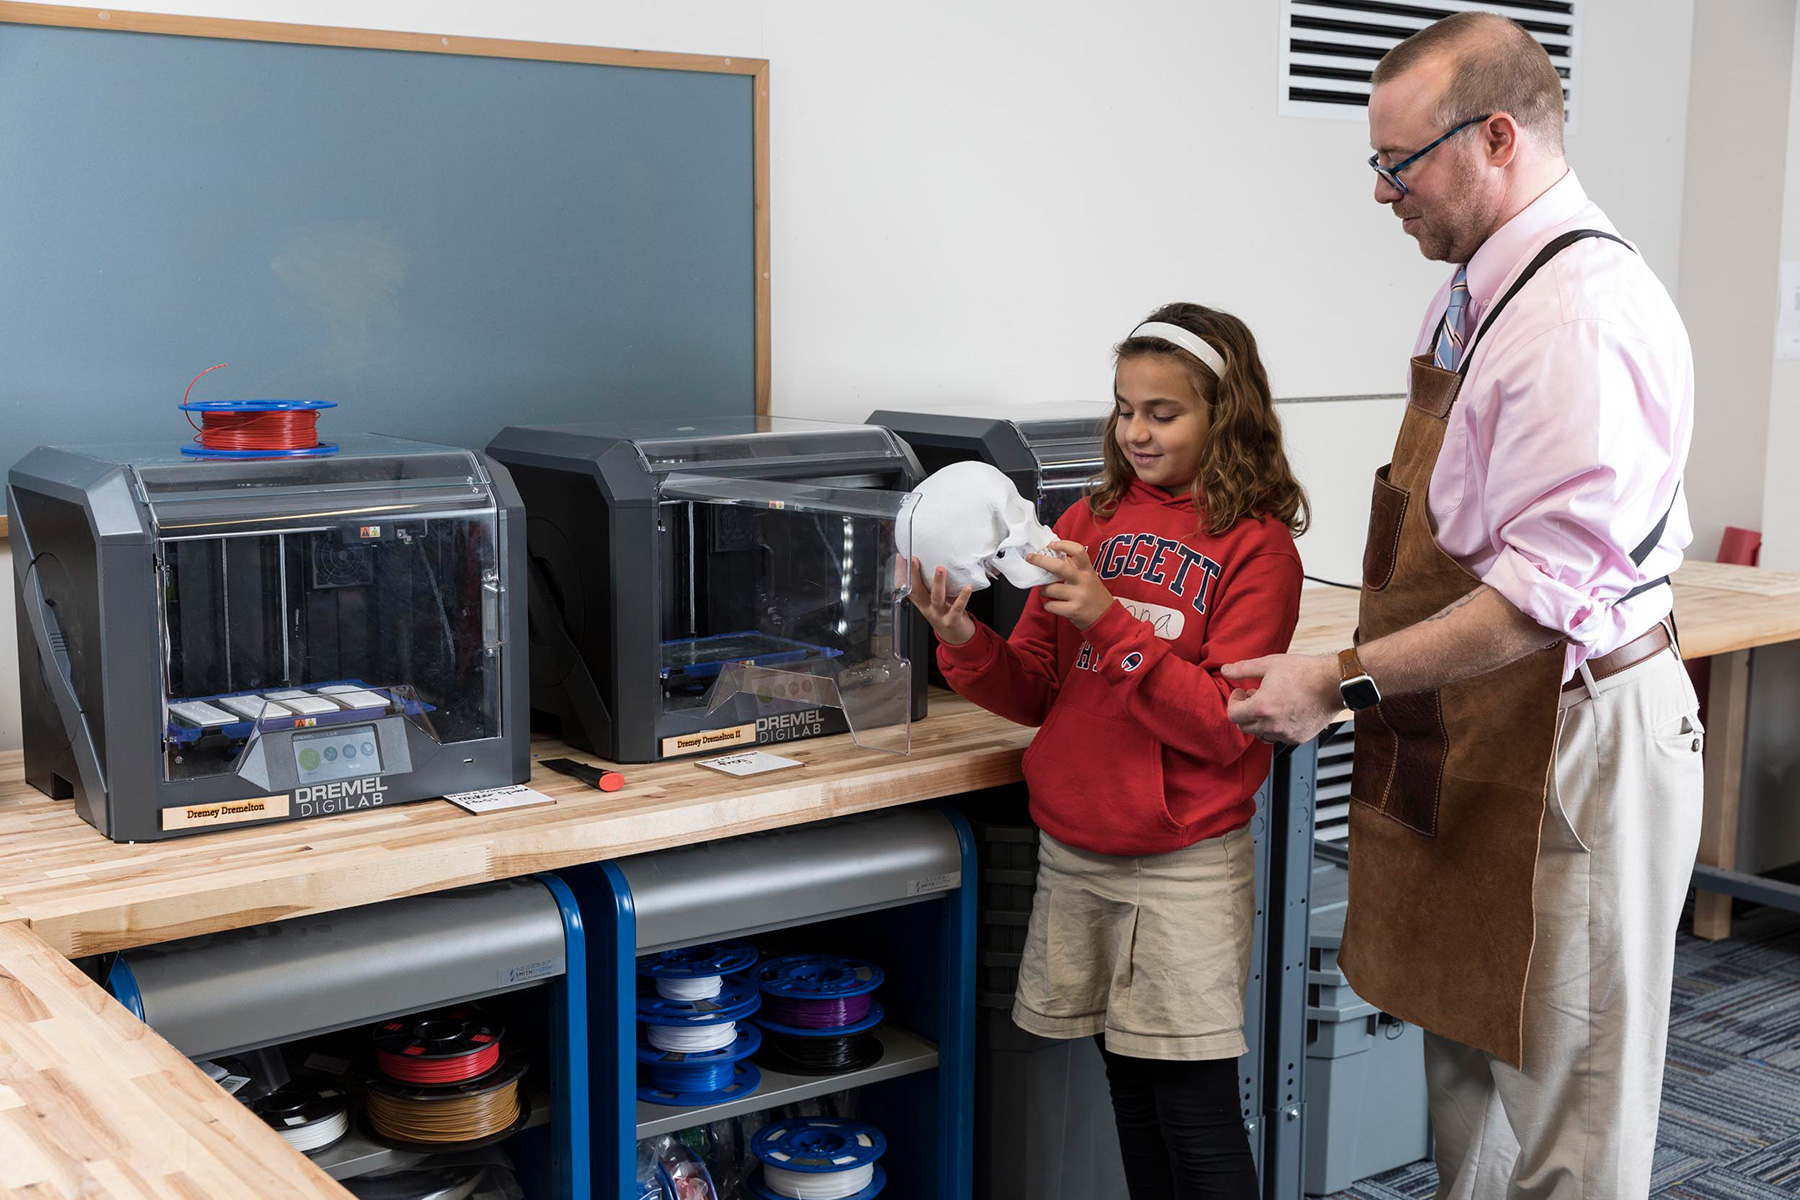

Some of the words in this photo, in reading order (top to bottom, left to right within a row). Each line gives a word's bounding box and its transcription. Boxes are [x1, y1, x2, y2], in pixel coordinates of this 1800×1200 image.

[755, 709, 825, 732] DREMEL
[677, 739, 702, 748] Dremey
[702, 732, 735, 744] Dremelton
[760, 723, 822, 743] DIGILAB
[295, 777, 388, 804] DREMEL
[187, 809, 220, 819] Dremey
[221, 803, 265, 815] Dremelton
[301, 792, 384, 817] DIGILAB
